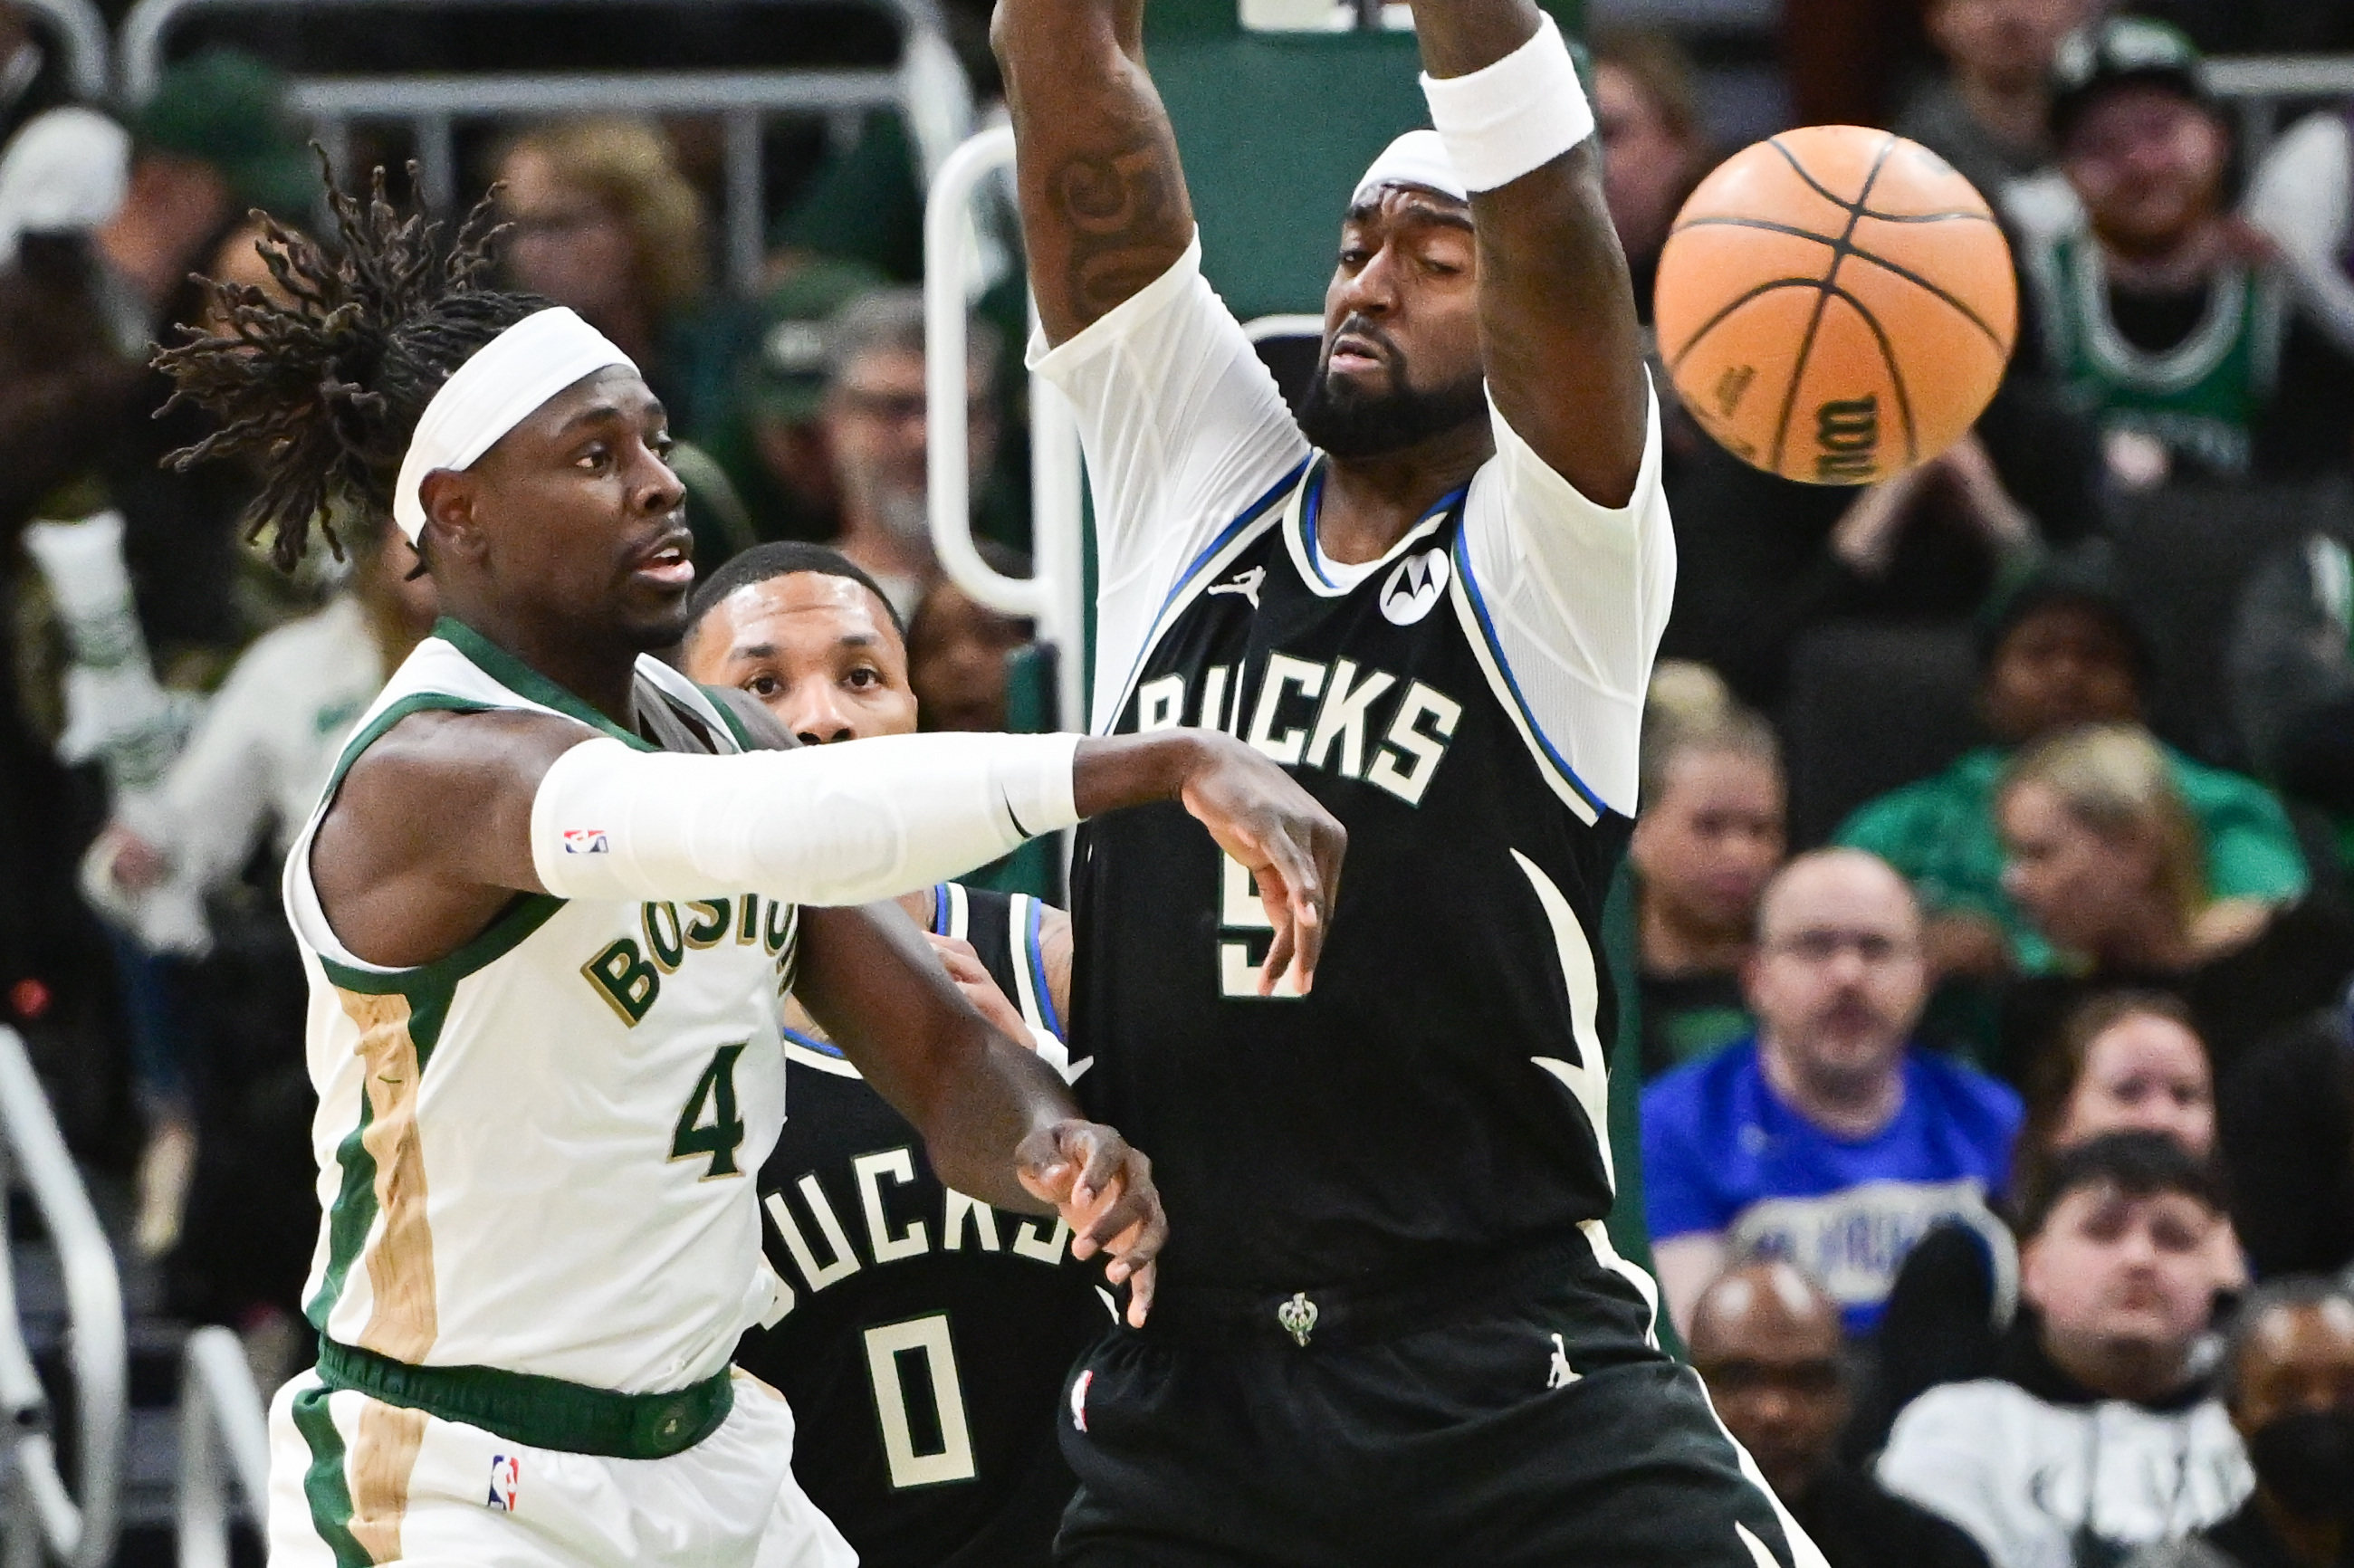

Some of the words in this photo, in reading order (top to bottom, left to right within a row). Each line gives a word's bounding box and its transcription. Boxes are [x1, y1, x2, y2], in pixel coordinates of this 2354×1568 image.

[665, 1039, 749, 1182] 4
[761, 1146, 1070, 1331] UCK
[862, 1314, 976, 1489] 0
